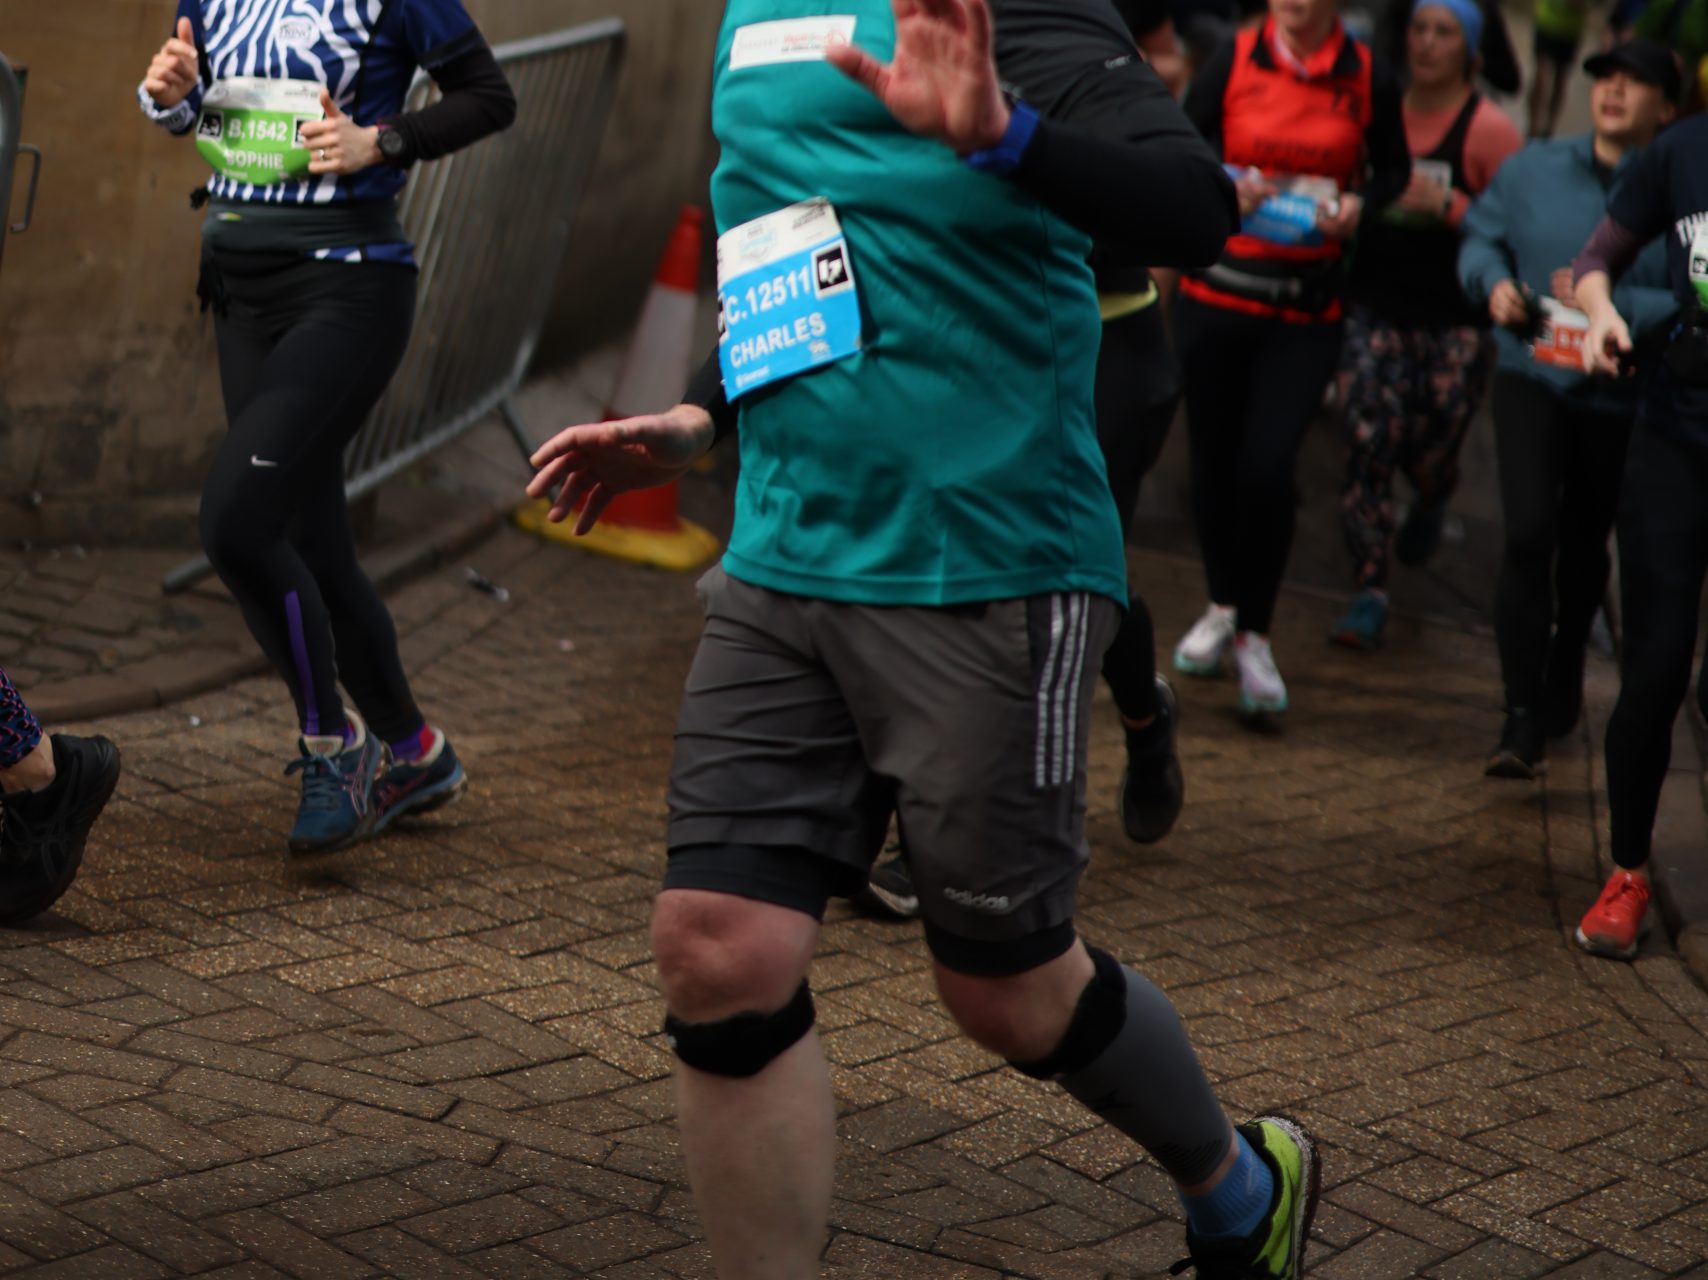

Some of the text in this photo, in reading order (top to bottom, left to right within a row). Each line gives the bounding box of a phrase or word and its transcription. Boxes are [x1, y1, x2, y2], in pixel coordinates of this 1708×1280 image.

[225, 149, 285, 170] SOPHIE
[724, 265, 812, 326] C.12511
[729, 311, 827, 369] CHARLES
[943, 887, 1009, 911] adidas
